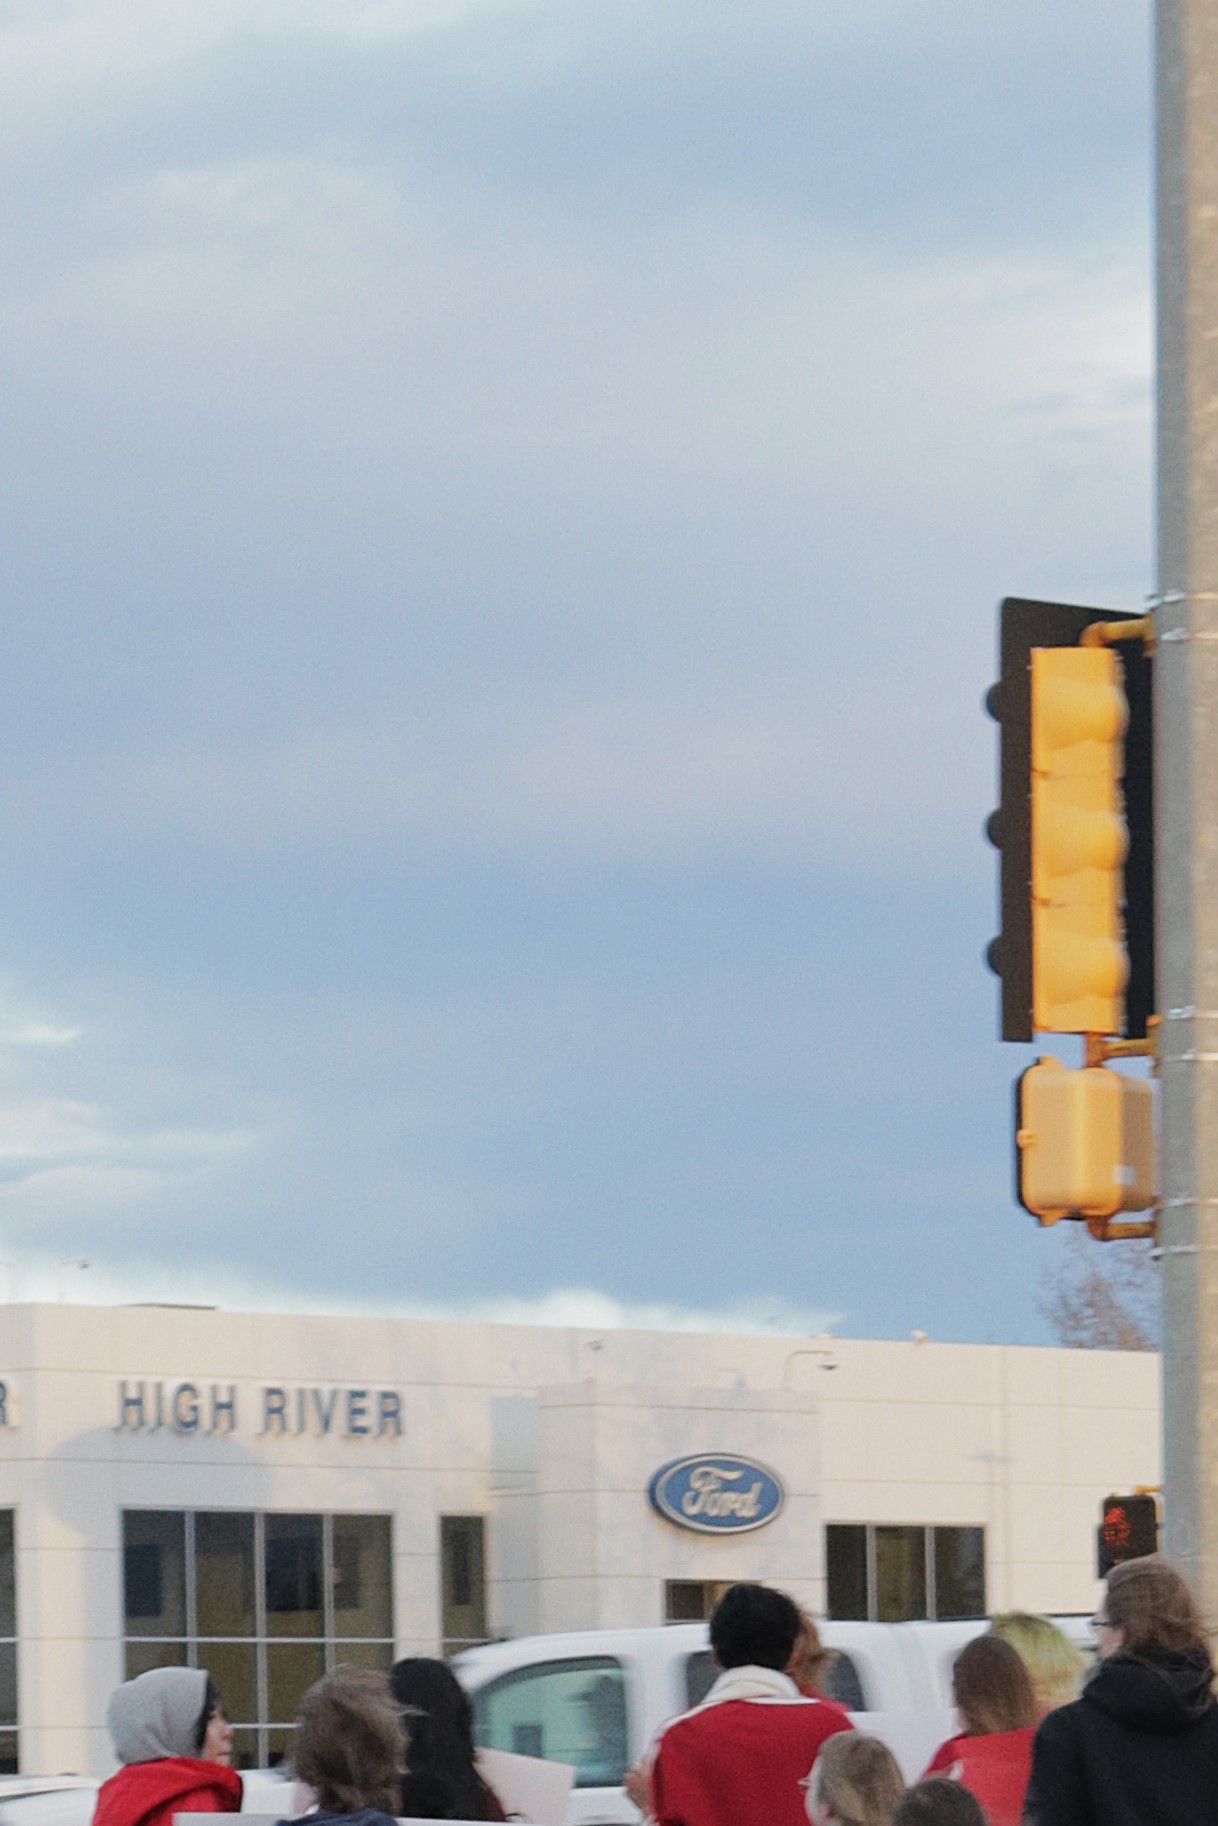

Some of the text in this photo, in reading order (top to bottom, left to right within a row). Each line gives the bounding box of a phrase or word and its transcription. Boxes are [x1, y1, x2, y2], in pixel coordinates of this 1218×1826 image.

[117, 1380, 404, 1435] HIGH RIVER
[682, 1466, 763, 1518] Ford
